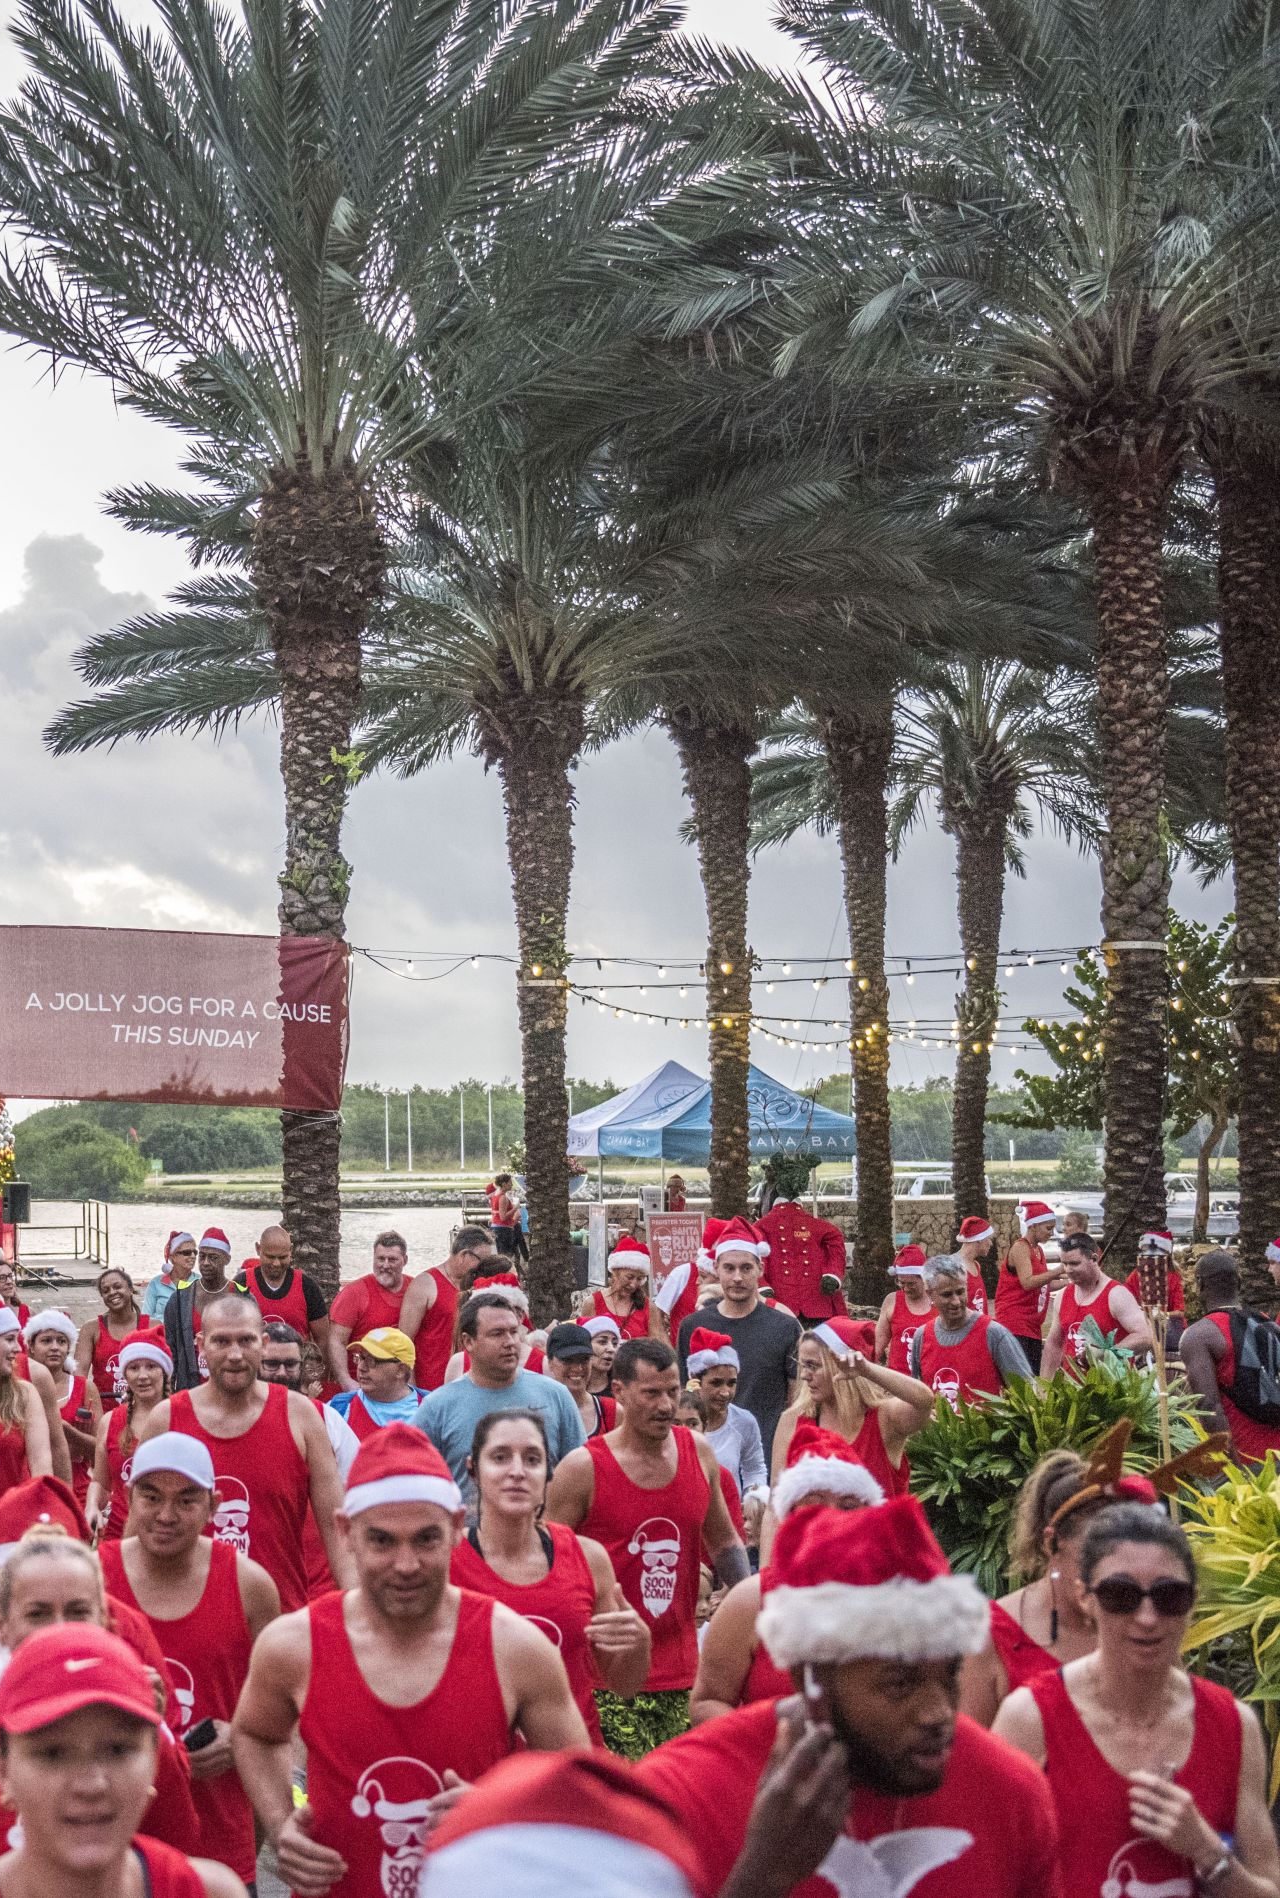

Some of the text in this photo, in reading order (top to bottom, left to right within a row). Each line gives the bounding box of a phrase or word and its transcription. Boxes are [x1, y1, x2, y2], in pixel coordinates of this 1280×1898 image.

[25, 992, 332, 1023] A JOLLY JOG FOR A CAUSE
[111, 1024, 261, 1049] THIS SUNDAY
[636, 1136, 650, 1147] BAY
[811, 1136, 851, 1147] BAY
[671, 1226, 699, 1236] SANTA
[672, 1235, 700, 1250] RUN
[645, 1576, 674, 1588] SOON
[644, 1588, 672, 1600] COME
